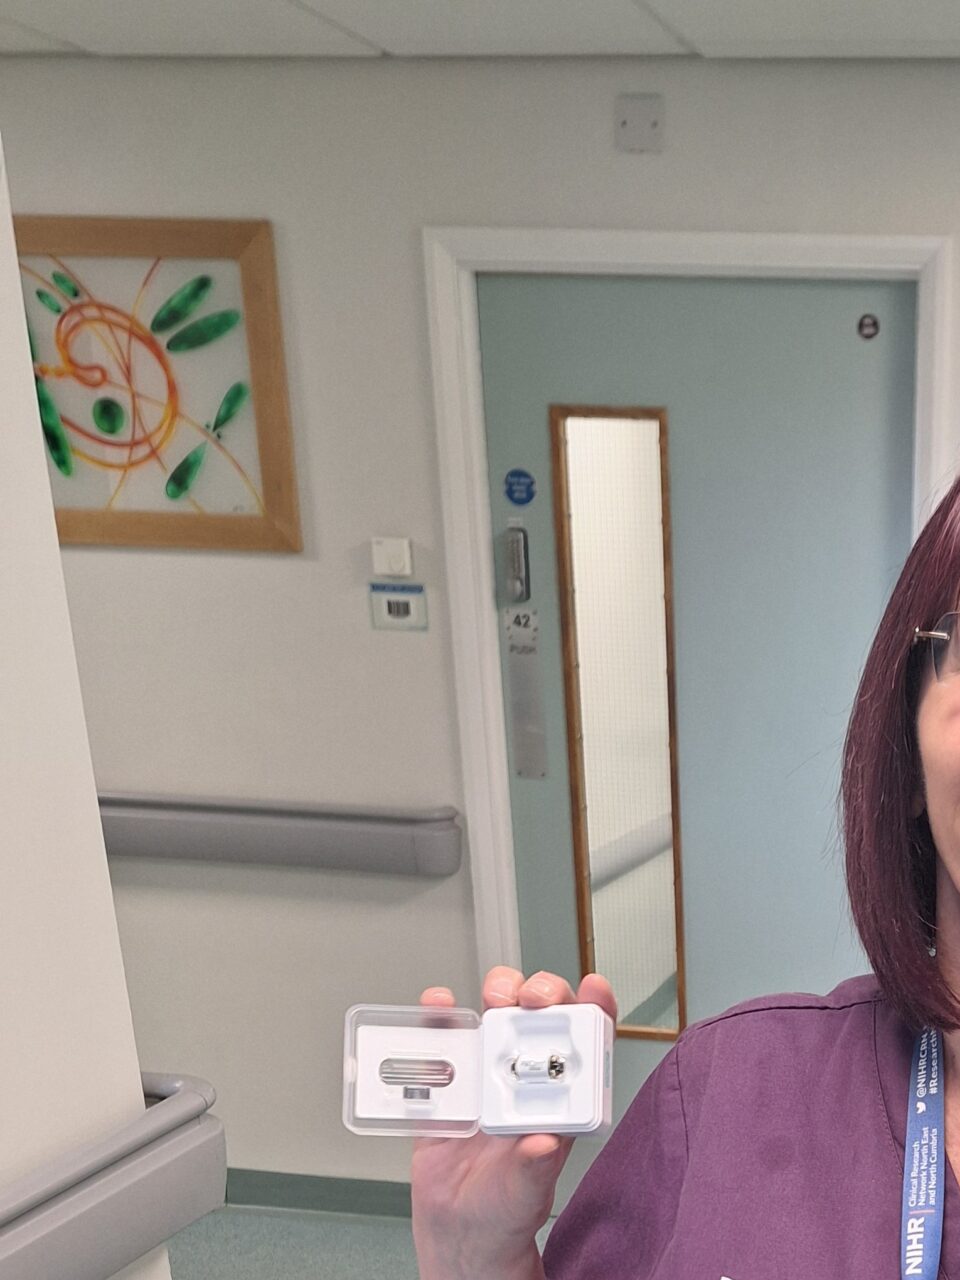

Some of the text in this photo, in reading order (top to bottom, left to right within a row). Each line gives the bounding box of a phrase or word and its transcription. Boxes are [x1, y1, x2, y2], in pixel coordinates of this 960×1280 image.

[513, 613, 531, 629] 42
[917, 1126, 928, 1205] Network North East
[929, 1128, 937, 1163] Cumbria
[908, 1140, 919, 1206] Clinical Research
[928, 1164, 936, 1188] North
[905, 1216, 925, 1275] NIHR
